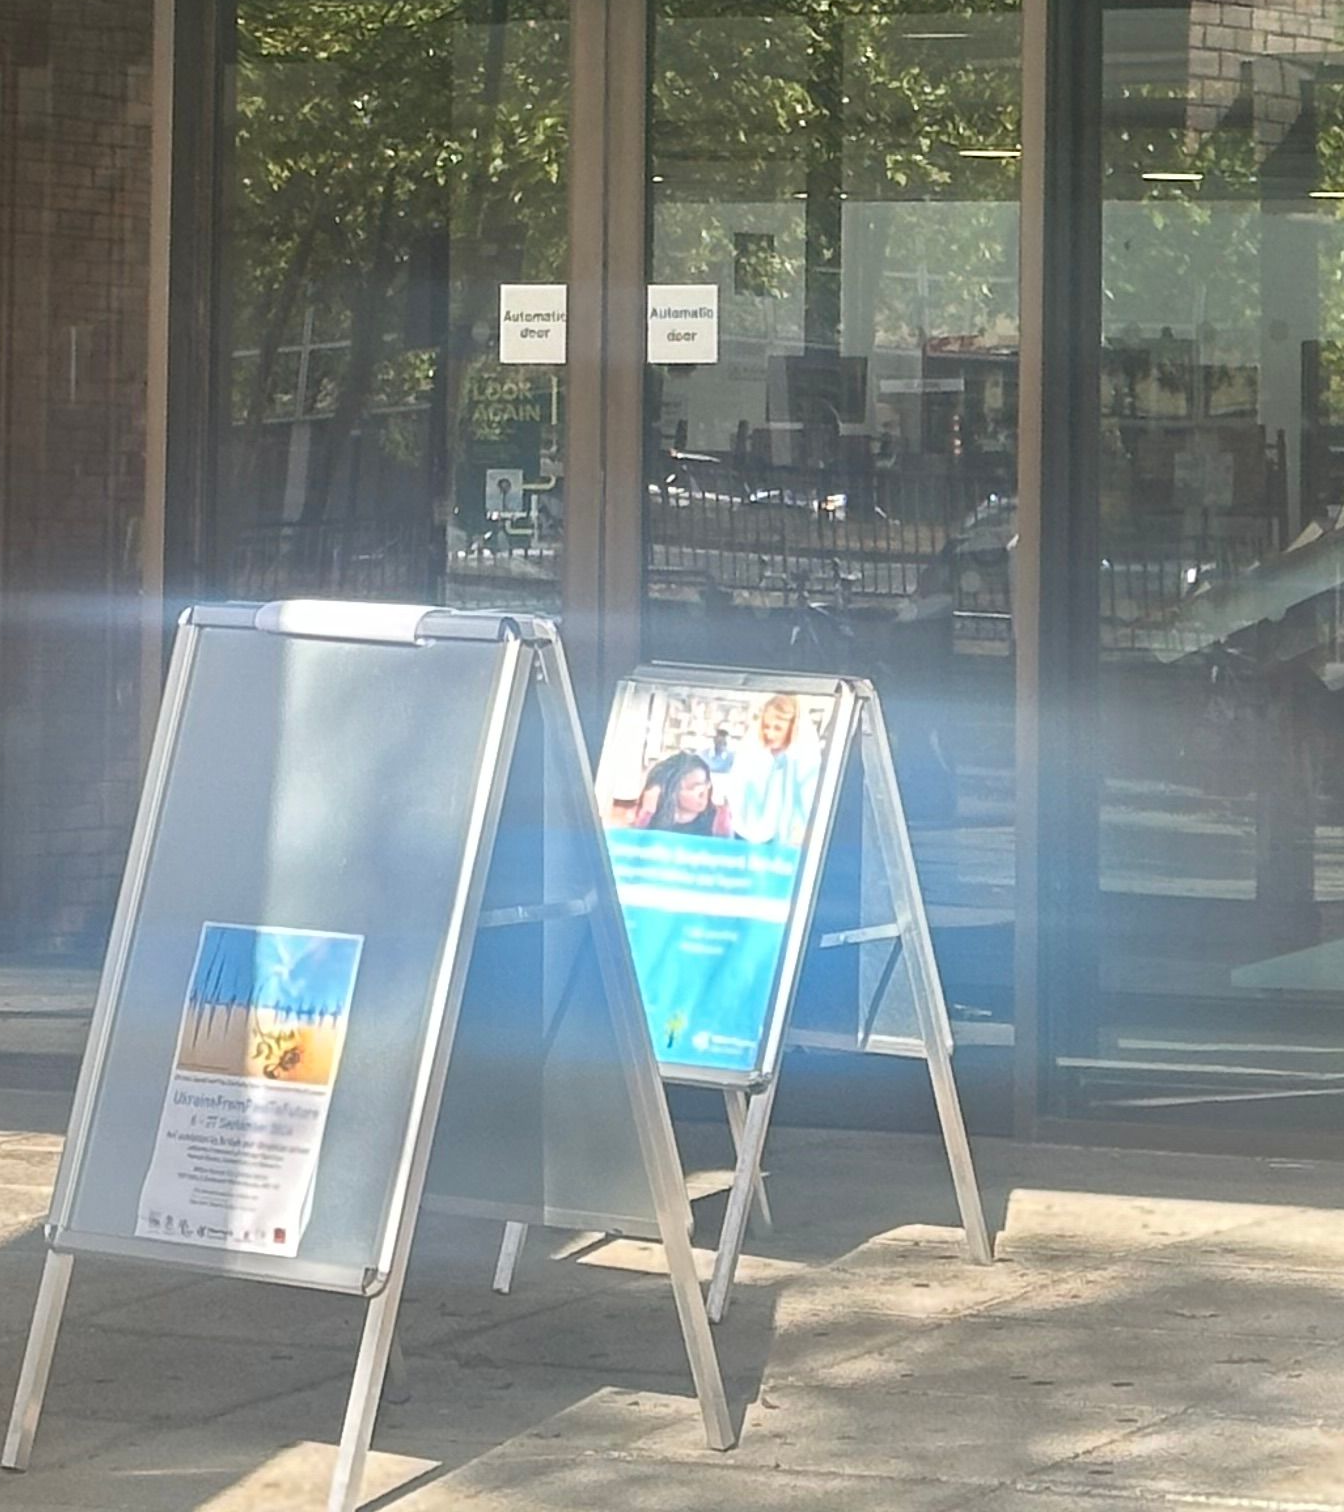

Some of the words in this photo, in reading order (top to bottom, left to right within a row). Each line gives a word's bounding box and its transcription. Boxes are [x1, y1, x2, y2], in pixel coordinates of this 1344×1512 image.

[503, 310, 567, 323] Automatic
[650, 307, 714, 320] Automatic
[519, 327, 551, 339] door
[666, 329, 698, 343] door
[472, 404, 542, 423] AGAIN
